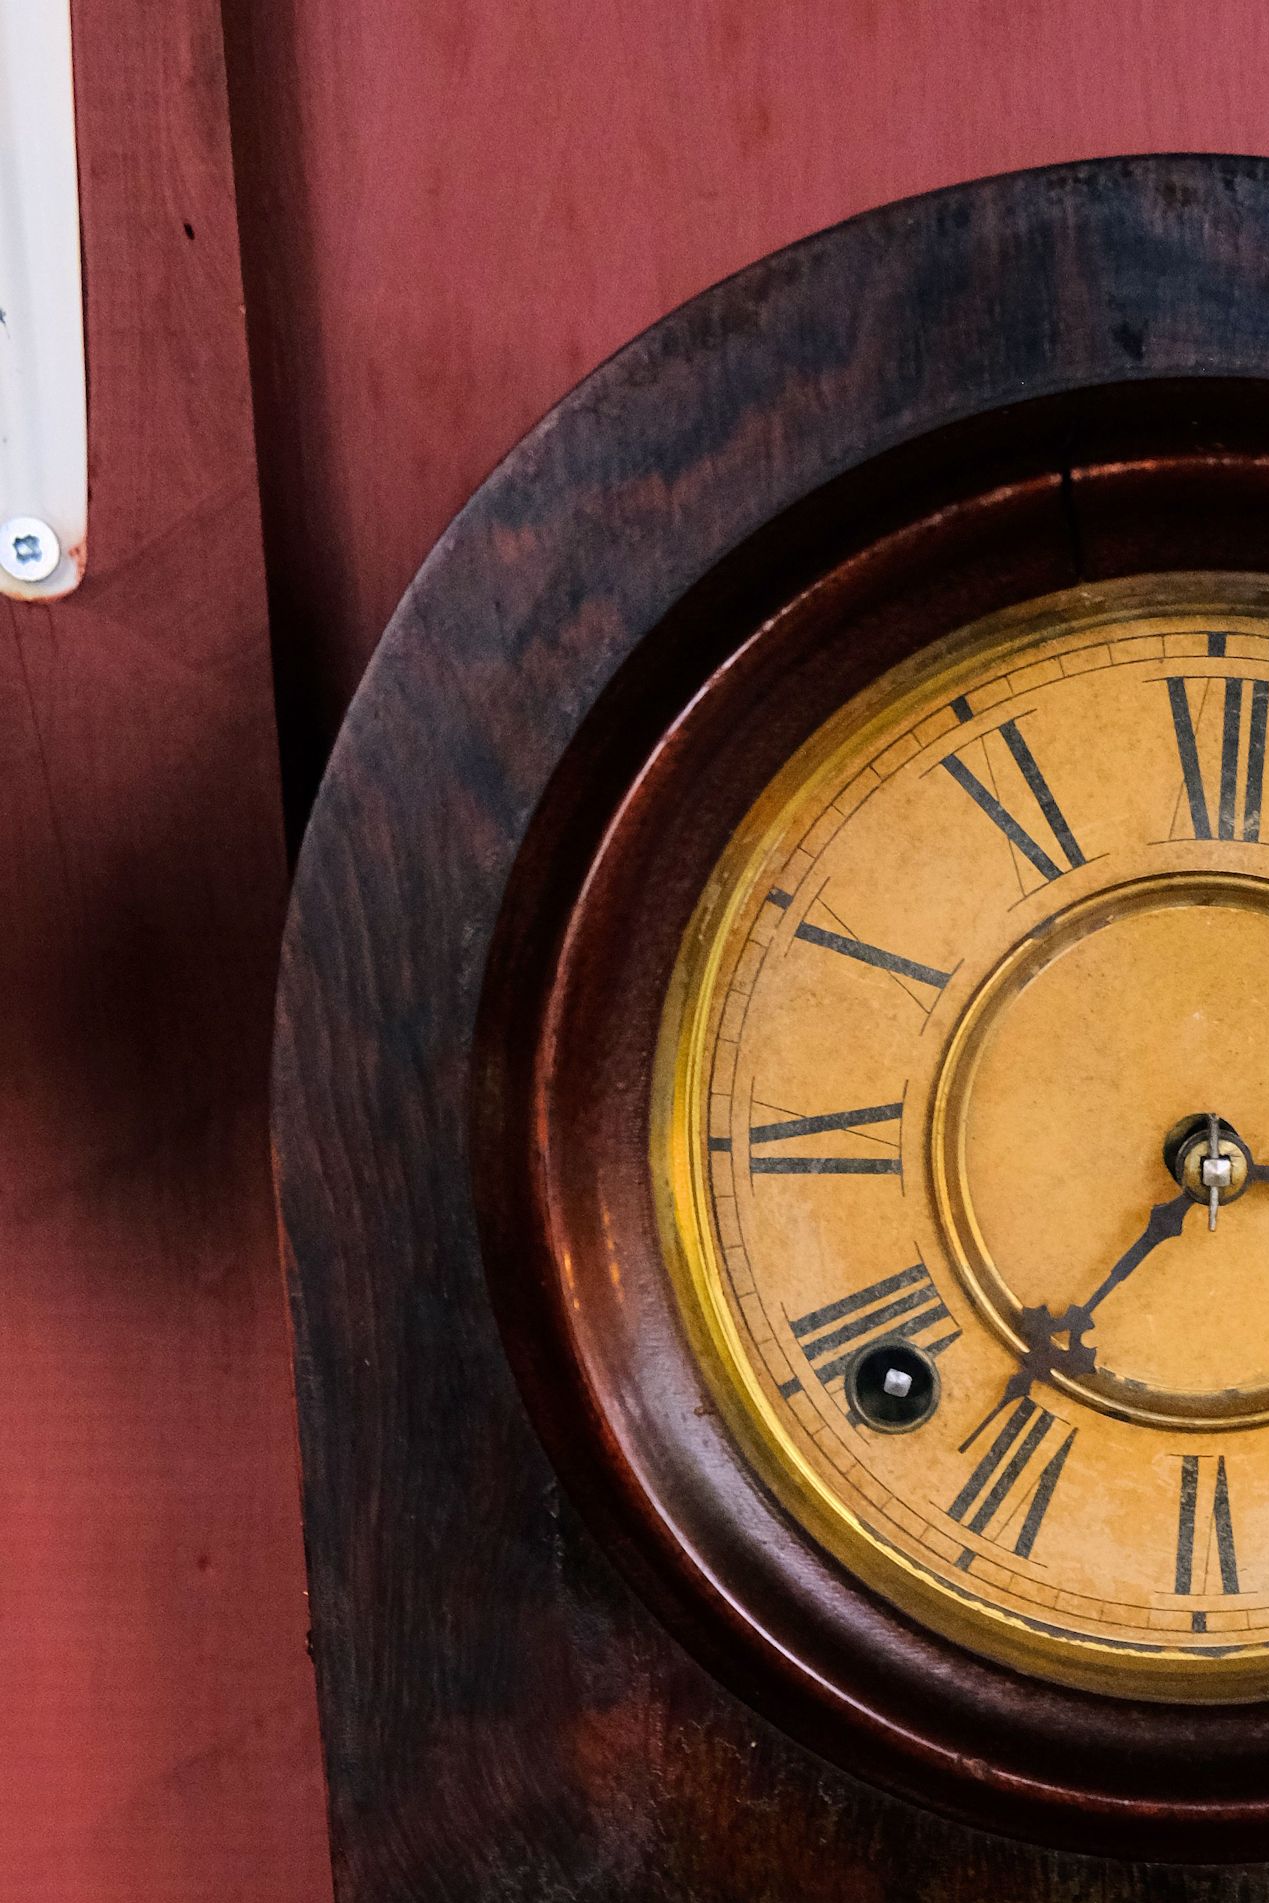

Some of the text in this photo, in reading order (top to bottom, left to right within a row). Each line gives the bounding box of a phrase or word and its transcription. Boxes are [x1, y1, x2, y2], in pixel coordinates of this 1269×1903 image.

[919, 709, 1111, 911] XI
[786, 876, 964, 1036] X
[748, 1080, 908, 1197] IX
[920, 1398, 1078, 1567] VII
